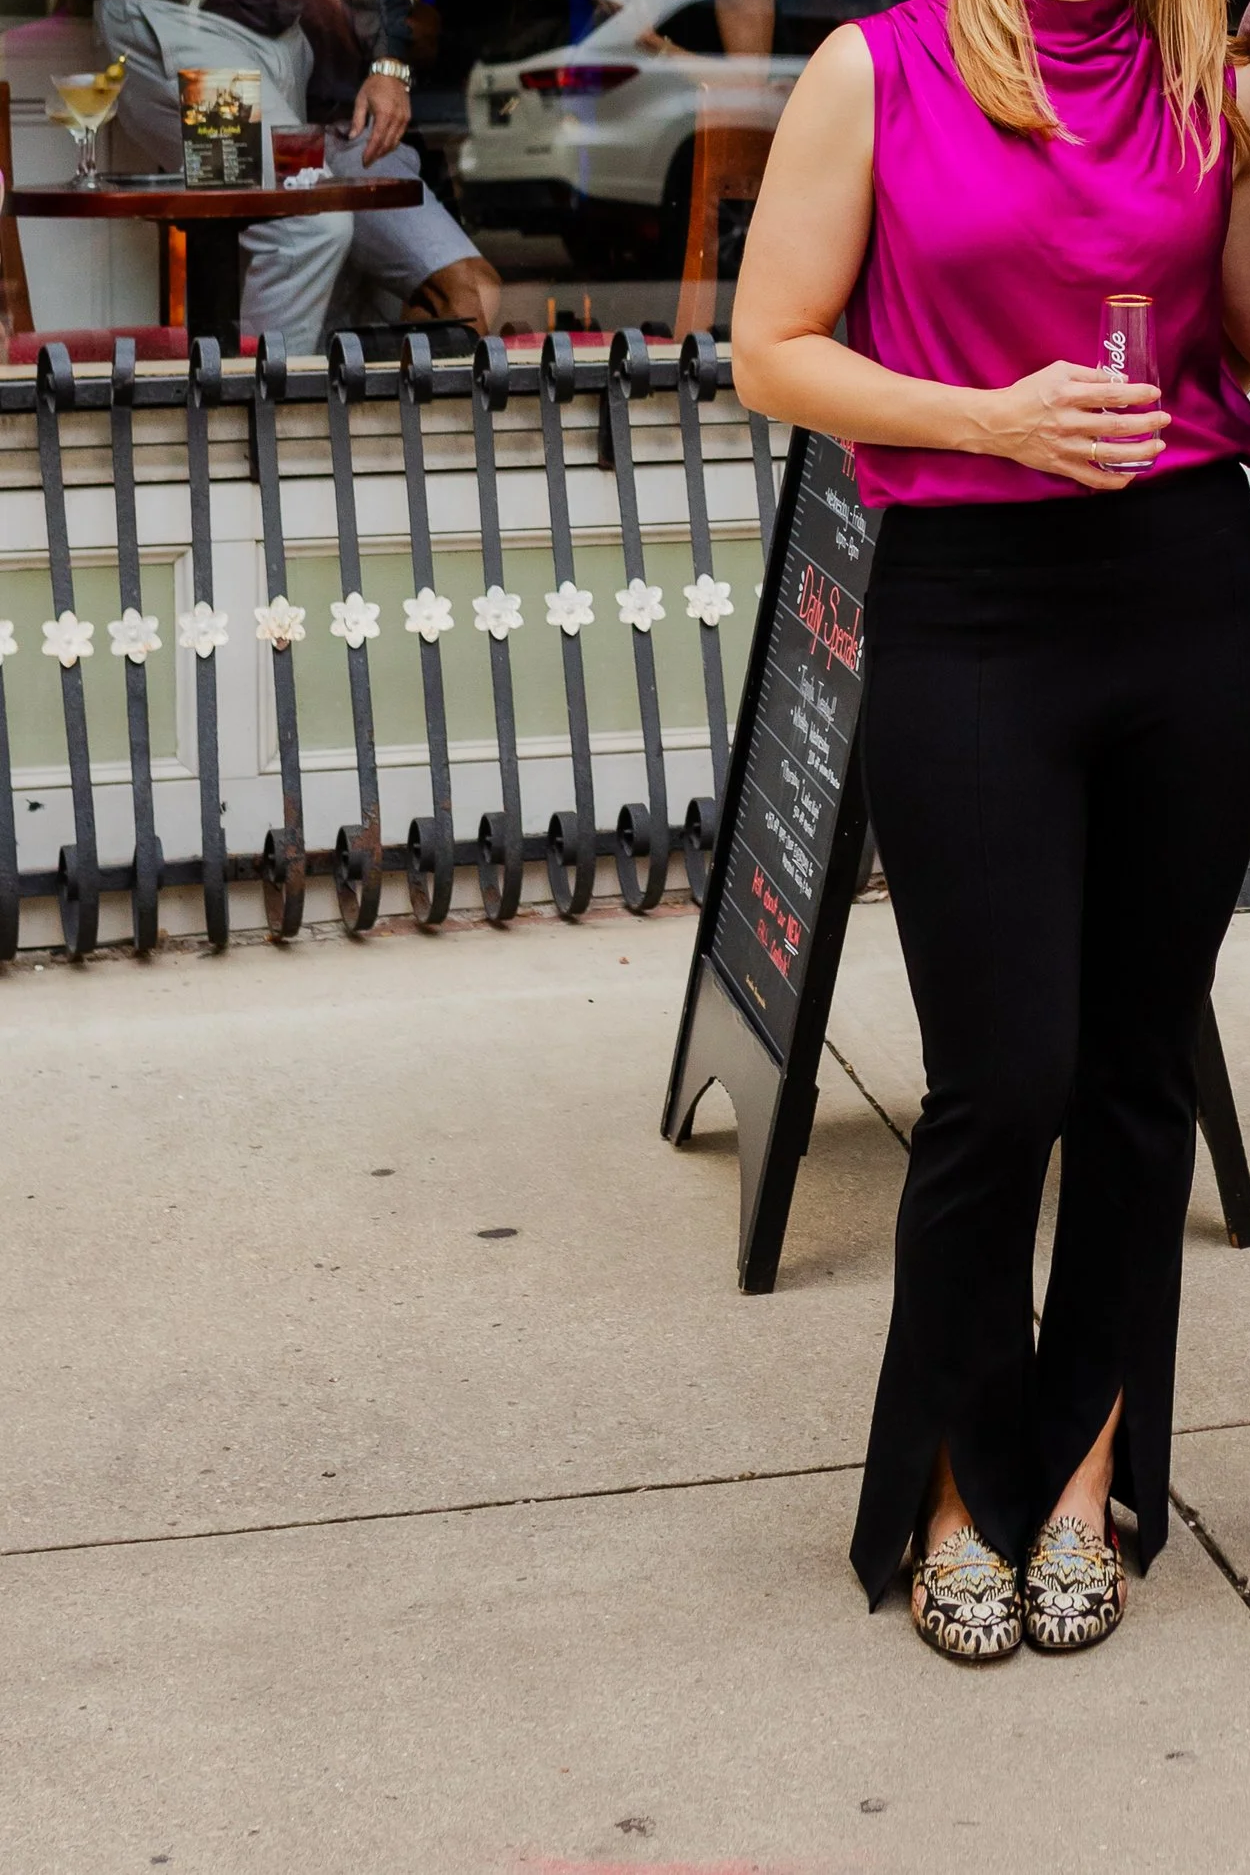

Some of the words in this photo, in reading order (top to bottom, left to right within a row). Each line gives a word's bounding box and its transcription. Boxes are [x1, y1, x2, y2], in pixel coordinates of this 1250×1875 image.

[1101, 330, 1127, 415] chele
[800, 565, 825, 655] Daily
[824, 586, 860, 671] Specials
[752, 866, 765, 899] Ask
[763, 885, 779, 917] about
[786, 912, 801, 947] NEW
